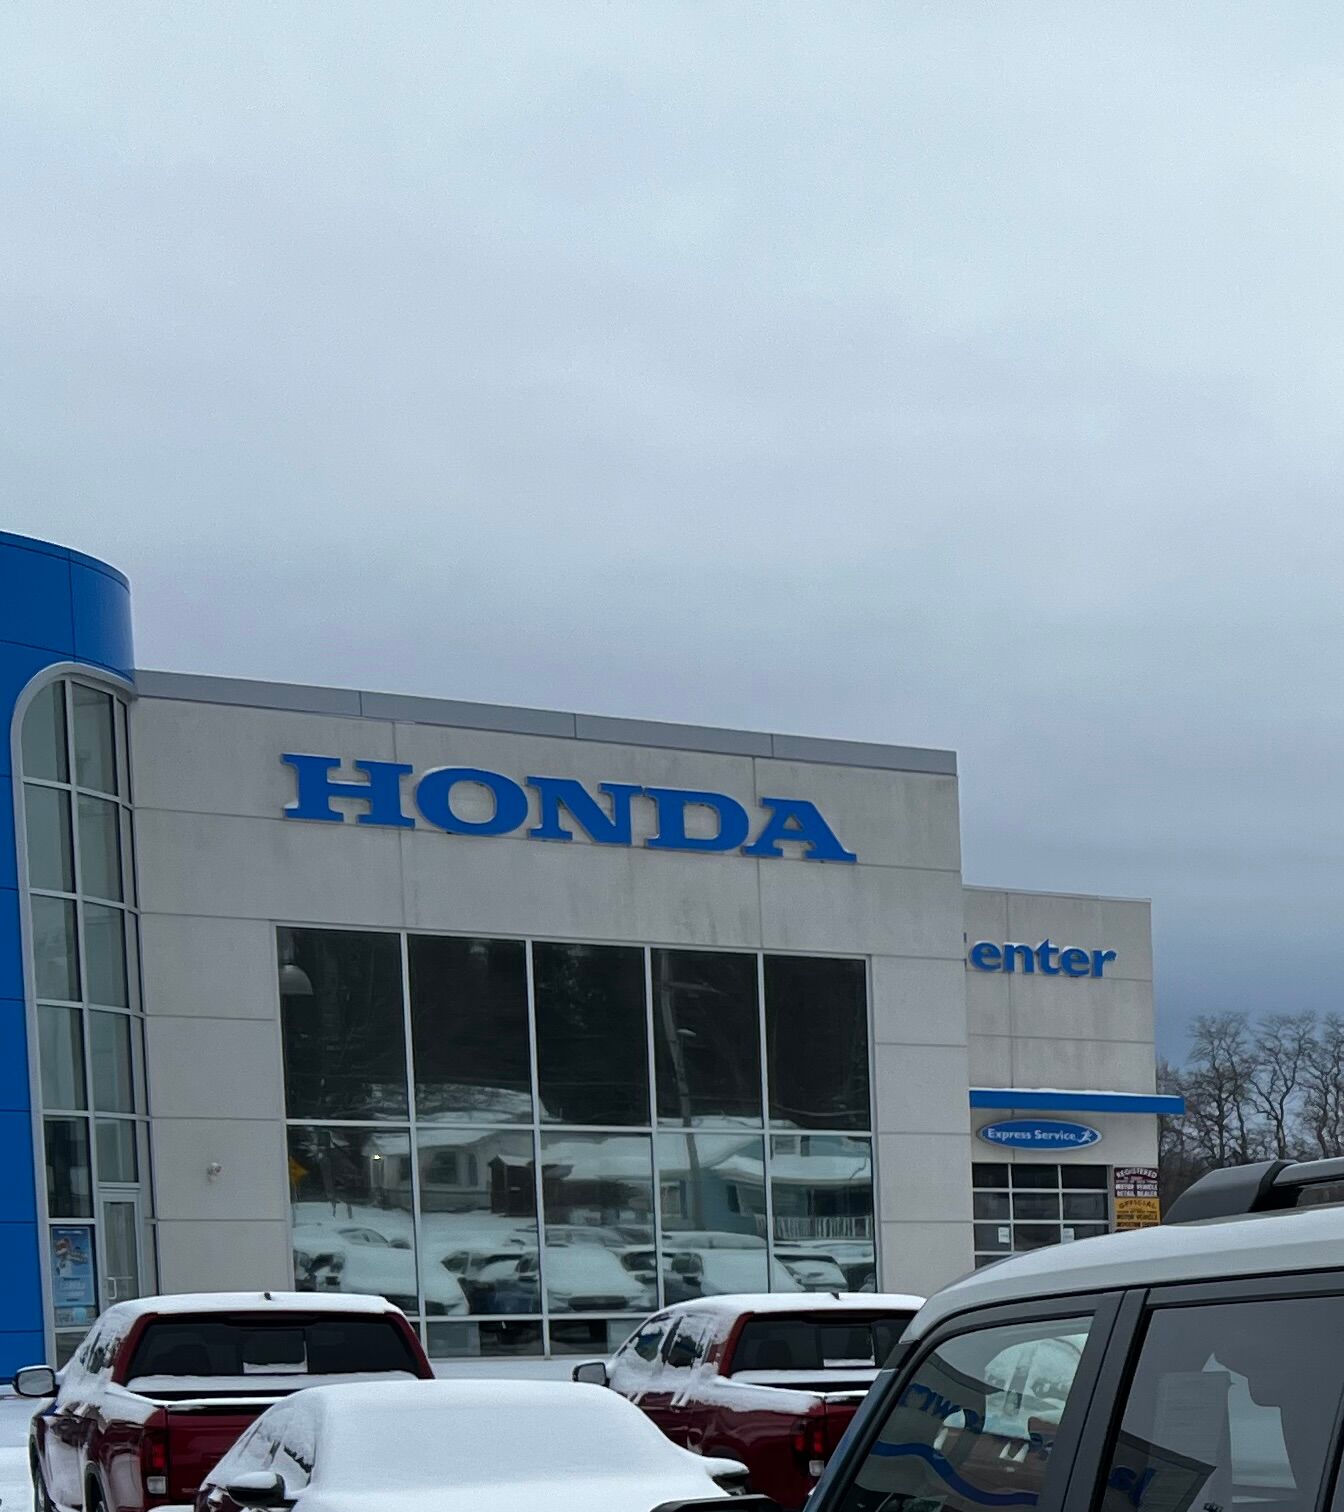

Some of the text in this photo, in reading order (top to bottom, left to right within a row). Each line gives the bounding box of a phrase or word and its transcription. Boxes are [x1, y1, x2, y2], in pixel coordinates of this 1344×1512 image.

[282, 753, 858, 863] HONDA
[964, 932, 1118, 978] enter
[987, 1128, 1076, 1141] Express Service
